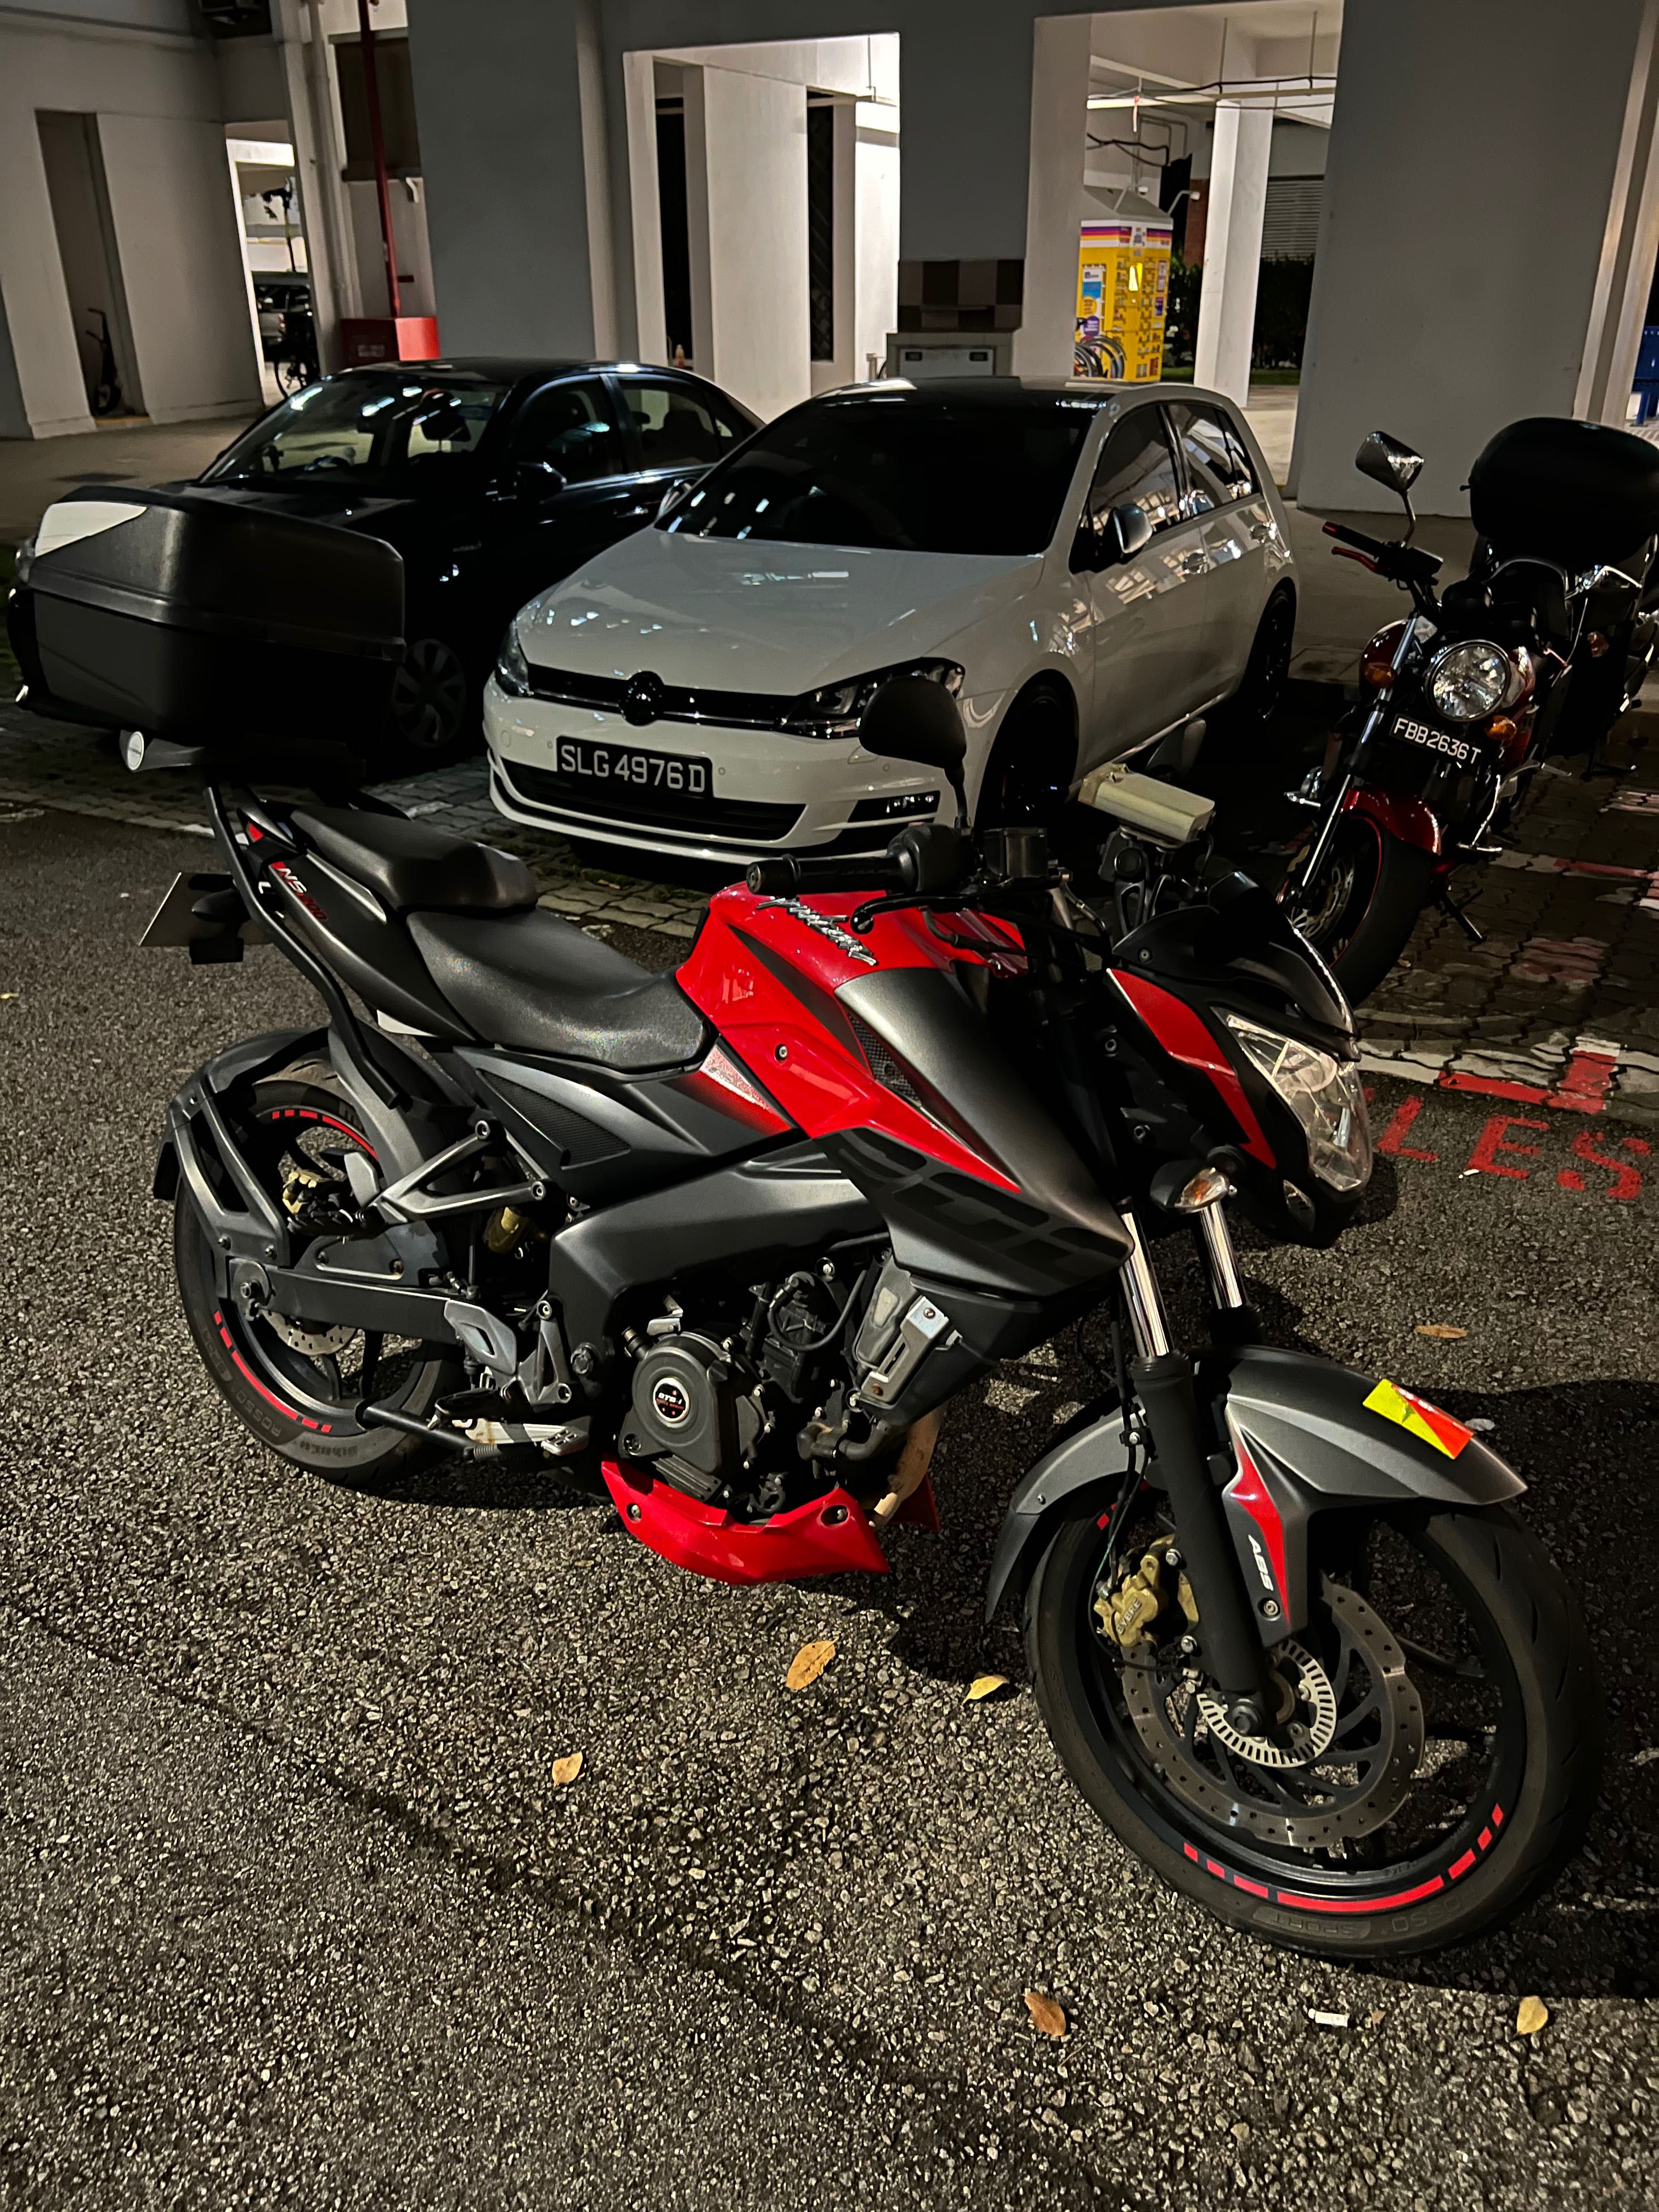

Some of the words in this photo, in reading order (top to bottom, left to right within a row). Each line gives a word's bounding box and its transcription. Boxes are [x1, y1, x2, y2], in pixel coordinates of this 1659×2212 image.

[1393, 717, 1482, 764] FBB2636T
[561, 744, 706, 793] SLG4976D
[1364, 1088, 1651, 1200] LES
[1248, 1534, 1274, 1591] ABS
